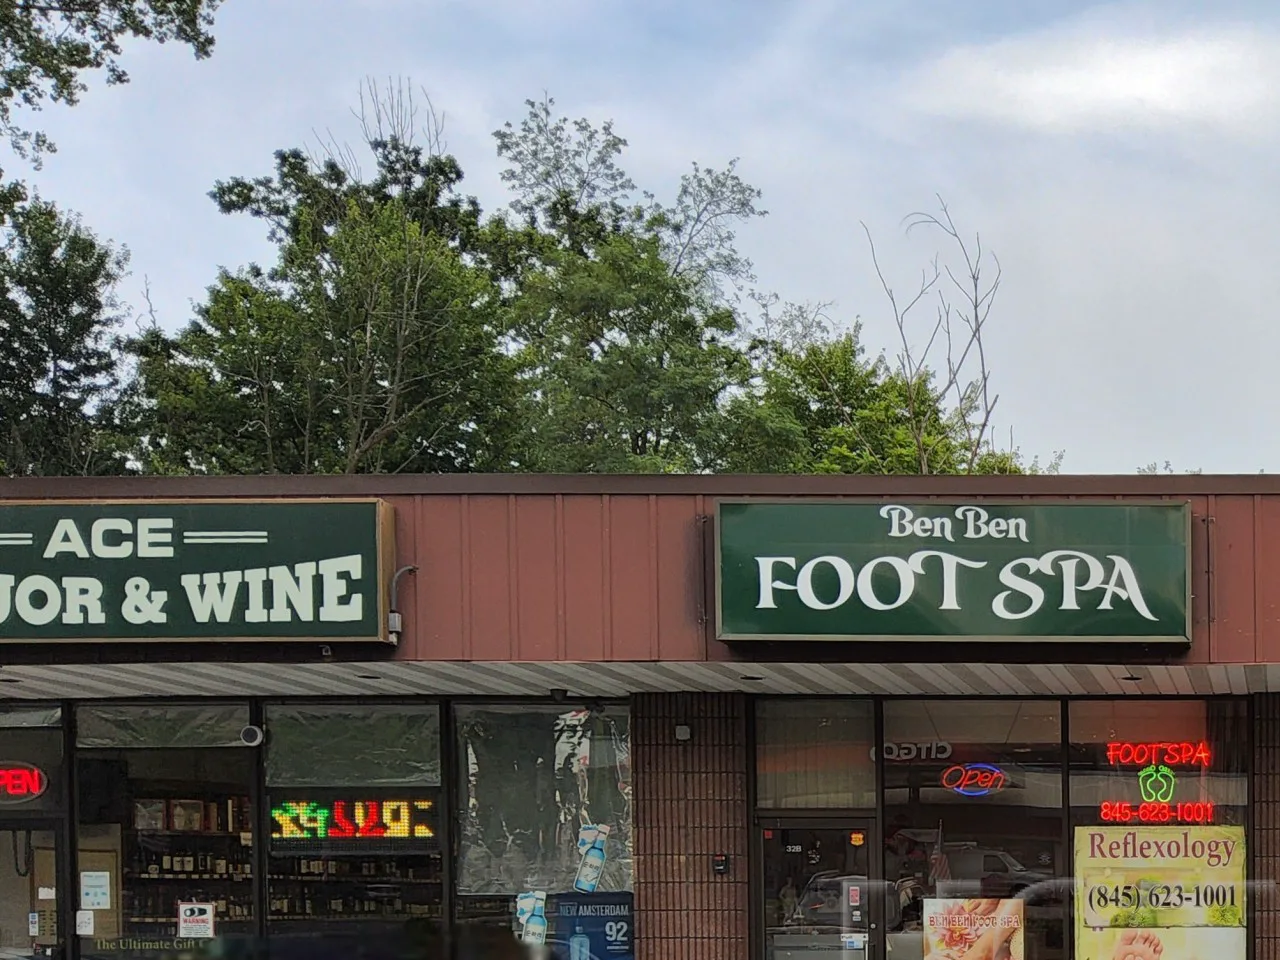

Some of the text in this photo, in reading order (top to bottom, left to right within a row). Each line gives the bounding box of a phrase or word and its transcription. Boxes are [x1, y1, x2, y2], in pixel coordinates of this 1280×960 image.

[880, 504, 1030, 543] Ben Ben
[43, 518, 174, 559] ACE
[121, 576, 168, 625] &
[180, 554, 363, 624] WINE
[754, 549, 1160, 622] FOOT SPA
[1107, 741, 1212, 766] FOOT SPA
[941, 765, 1006, 790] Open
[1100, 802, 1214, 822] 845-623-1001
[1088, 831, 1237, 868] Reflexology
[578, 904, 629, 917] AMSTERDAM
[1088, 884, 1238, 915] (845) 623-1001
[96, 938, 116, 950] The
[119, 938, 171, 950] Ultimate
[173, 938, 195, 950] Gift
[604, 921, 629, 942] 92
